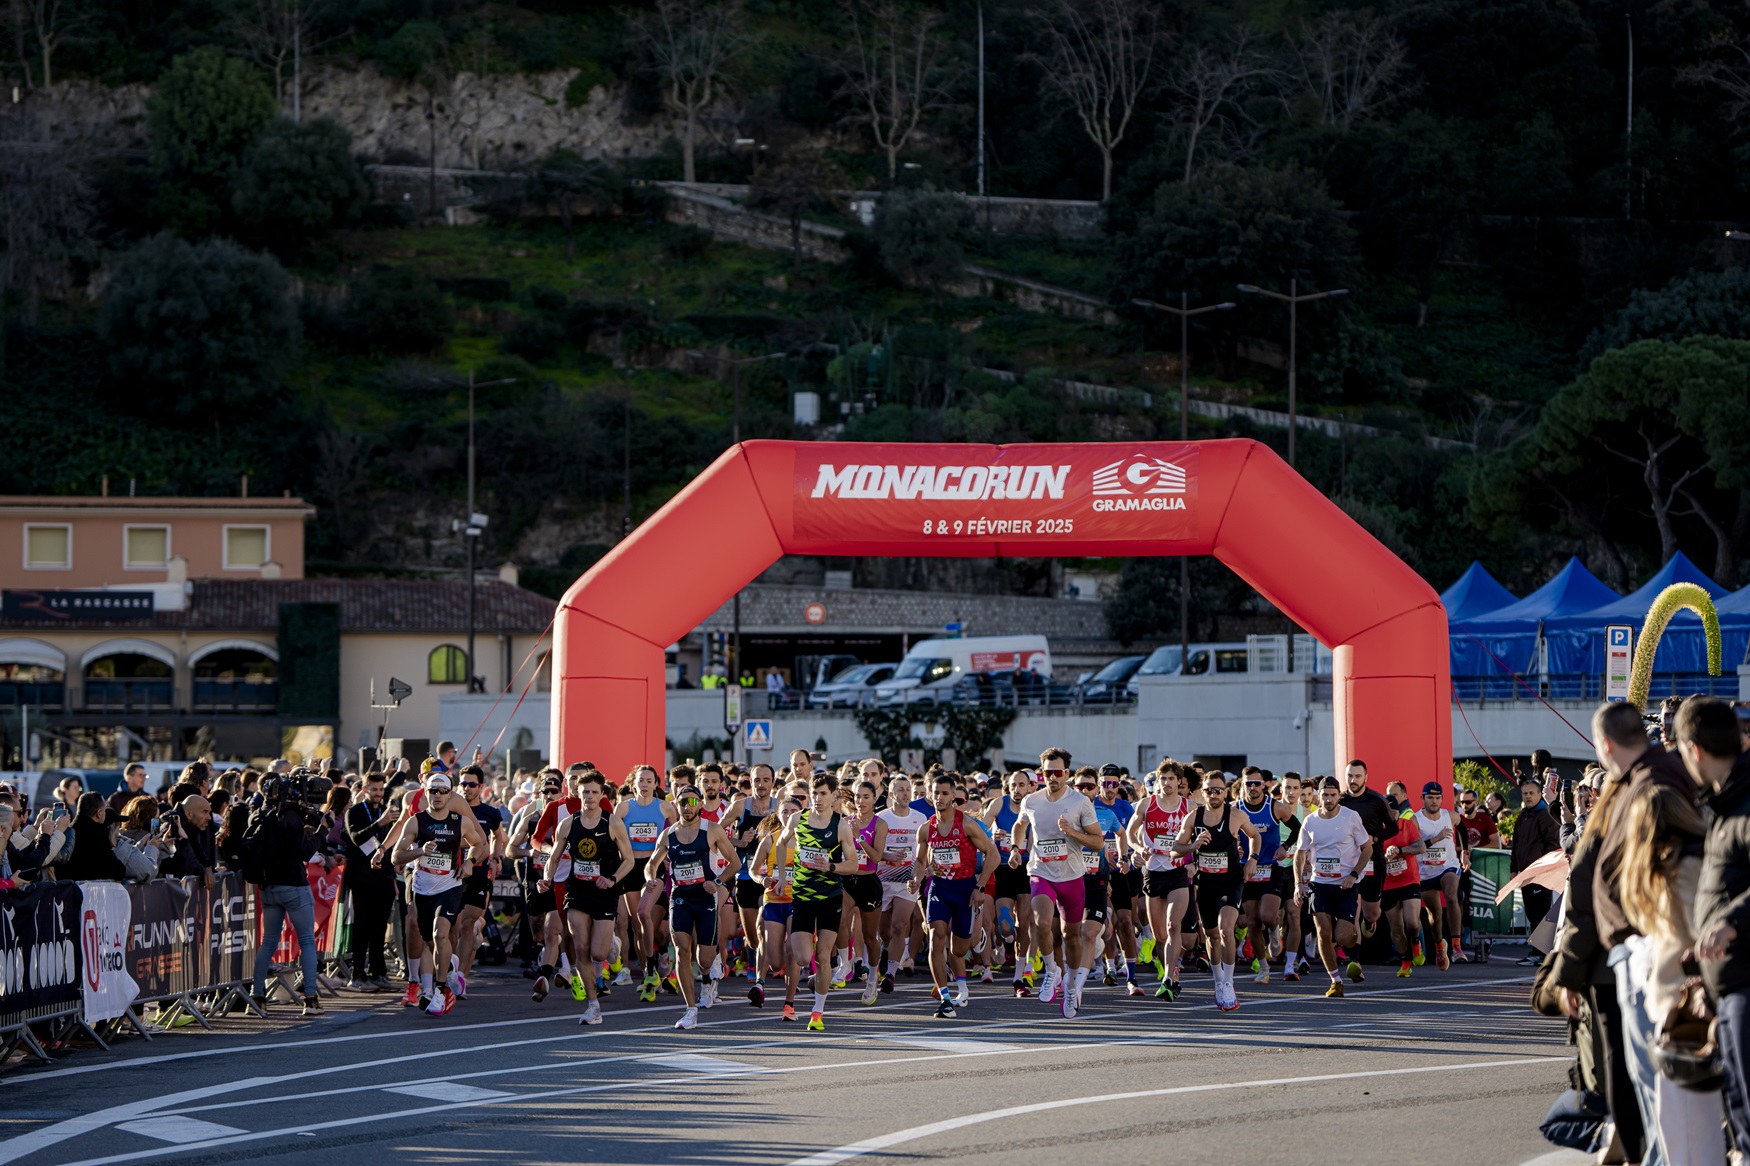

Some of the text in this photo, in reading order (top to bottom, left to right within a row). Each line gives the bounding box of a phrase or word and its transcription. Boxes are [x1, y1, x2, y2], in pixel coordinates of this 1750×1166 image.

[810, 464, 1072, 500] MONACORUN
[1092, 498, 1186, 511] GRAMAGLIA
[923, 516, 1074, 534] 8 & 9 FÉVRIER 2025
[1614, 631, 1625, 644] P
[1156, 821, 1182, 832] MONAC
[932, 839, 961, 848] MAROC
[1043, 845, 1059, 853] 2010
[427, 858, 445, 866] 2008
[680, 868, 695, 876] 2017
[133, 917, 195, 950] RUNNING
